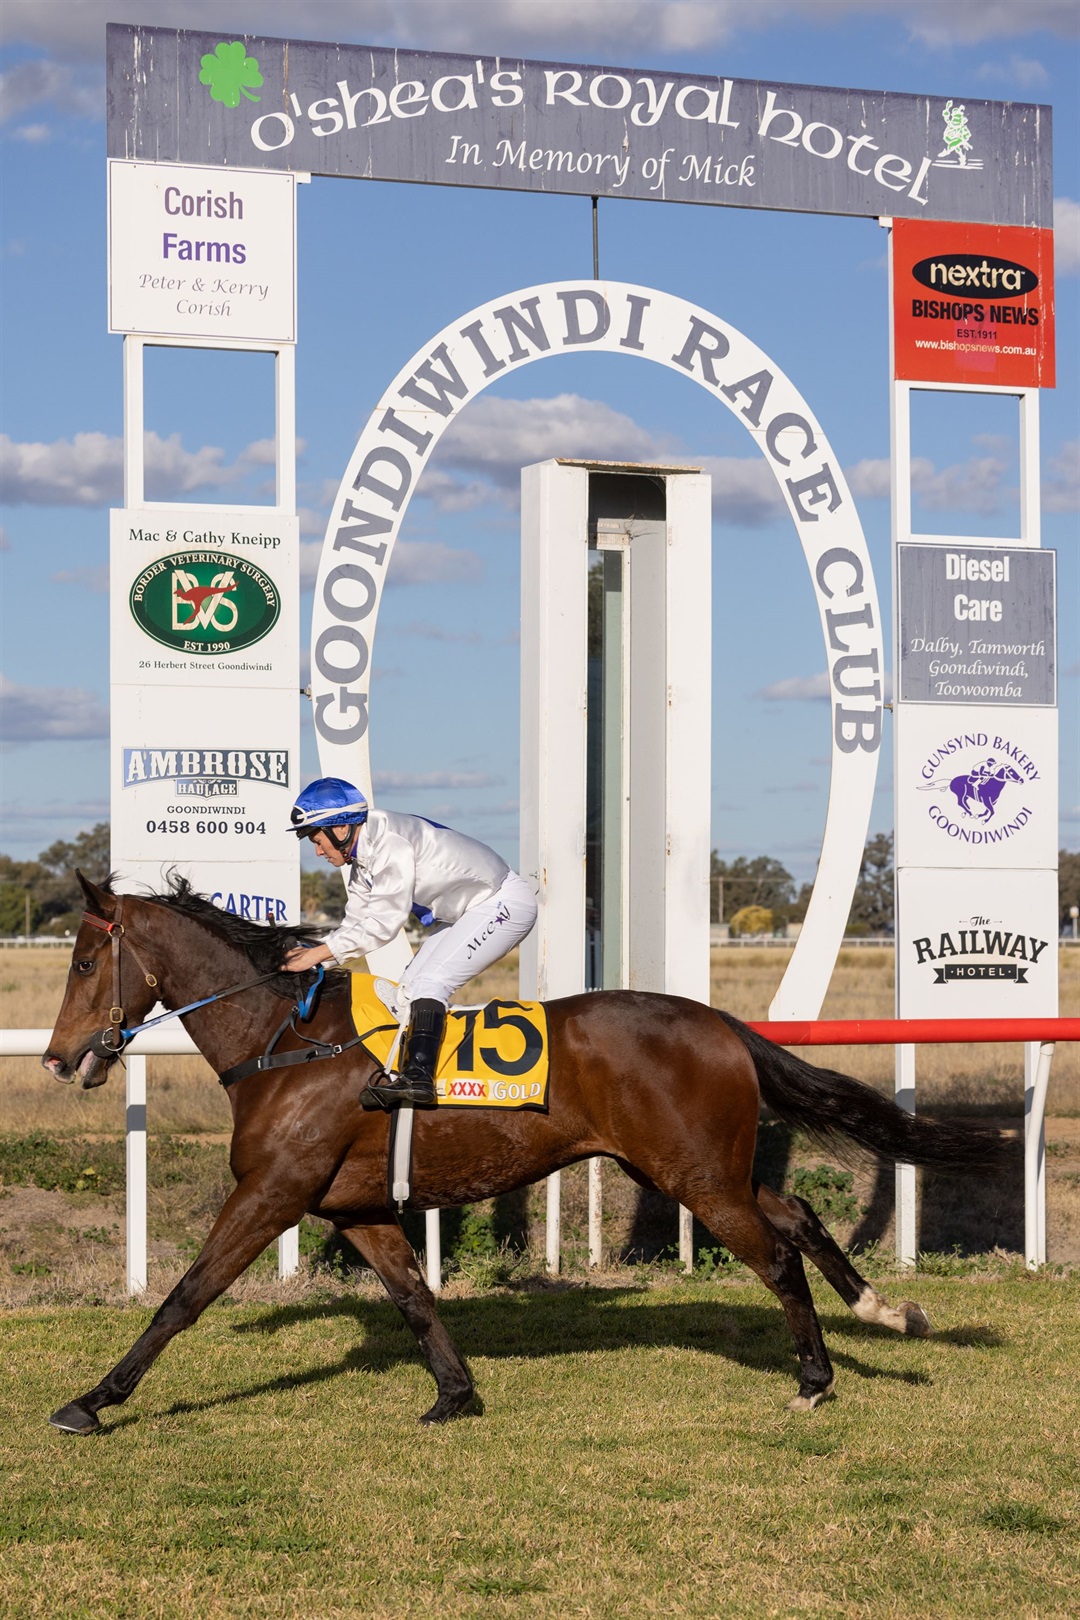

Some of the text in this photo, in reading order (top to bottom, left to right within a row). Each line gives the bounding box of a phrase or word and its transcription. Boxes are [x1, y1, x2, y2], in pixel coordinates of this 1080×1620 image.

[445, 135, 757, 191] In Memory of Mick
[164, 186, 243, 219] Corish
[163, 232, 247, 264] Farms
[930, 260, 1021, 290] nextra
[139, 273, 269, 301] Peter & Kerry
[176, 299, 232, 317] Corish
[912, 299, 1039, 326] BISHOPS NEWS
[957, 329, 998, 340] EST.1911
[915, 339, 1037, 356] www.bishopsnews.com.au
[315, 289, 882, 753] GOONDIWINDI RACE CLUB
[129, 528, 281, 549] Mac & Cathy Kneipp
[945, 553, 1010, 582] Diesel
[134, 553, 276, 608] BORDER VETERINARY SURGERY
[954, 594, 1003, 622] Care
[183, 640, 231, 652] EST 1990
[911, 636, 1046, 659] Dalby, Tamworth
[138, 660, 272, 671] 26 Herbert Street Goondiwindi
[928, 660, 1029, 679] Goondiwindi,
[934, 680, 1023, 698] Toowoomba
[921, 733, 1041, 782] GUNSYND BAKERY
[178, 783, 237, 797] HAULAGE
[167, 805, 246, 815] GOONDIWINDI
[146, 820, 266, 835] 0458 600 904
[928, 805, 1034, 844] GOONDIWINDI
[970, 916, 991, 927] The
[912, 929, 1049, 964] RAILWAY
[956, 967, 1005, 976] HOTEL
[451, 999, 543, 1076] 15
[448, 1081, 542, 1100] XXXX GOLD
